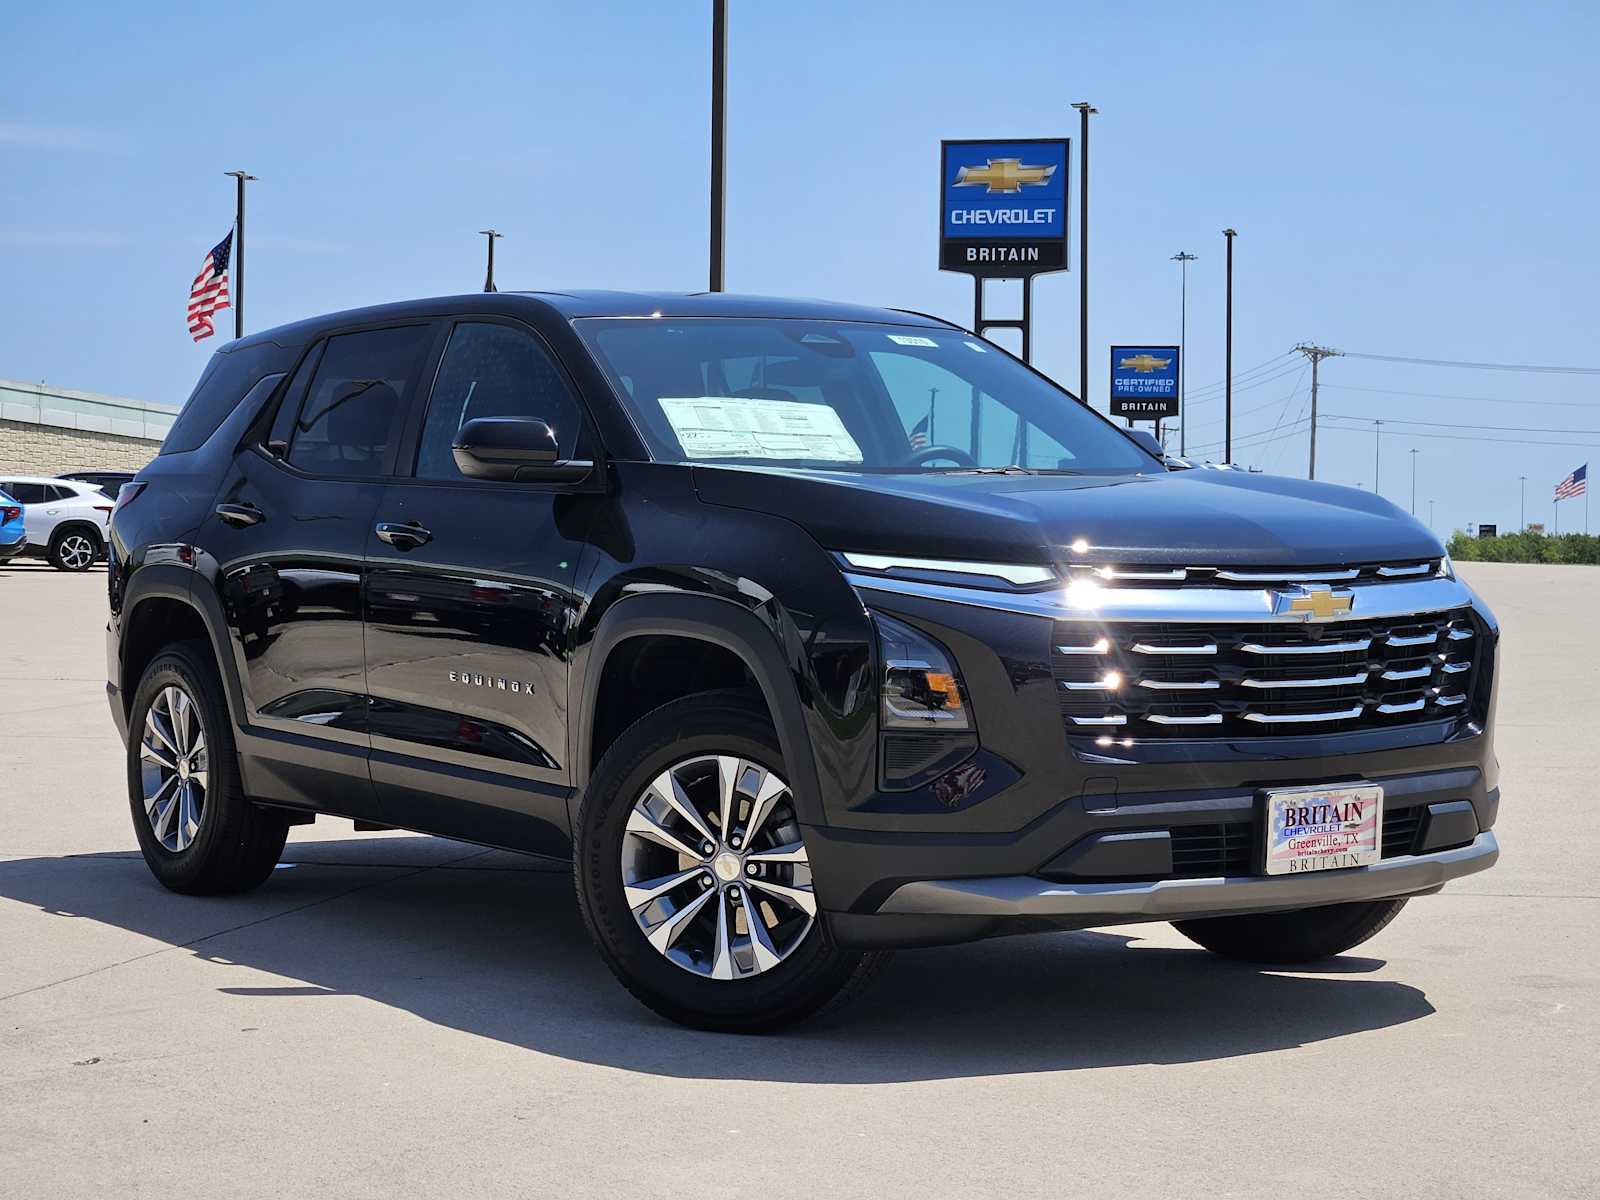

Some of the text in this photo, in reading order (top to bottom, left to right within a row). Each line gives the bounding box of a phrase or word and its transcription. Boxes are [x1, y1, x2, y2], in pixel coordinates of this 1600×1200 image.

[951, 208, 1056, 224] CHEVROLET
[966, 247, 1039, 261] BRITAIN
[1114, 378, 1175, 386] CERTIFIED
[1118, 385, 1171, 393] PRE-OWNED
[1121, 402, 1167, 411] BRITAIN
[449, 671, 535, 695] EQUINOX
[1285, 802, 1364, 827] BRITAIN
[1284, 824, 1342, 837] CHEVROLET
[1288, 832, 1359, 850] Greenville, TX
[1289, 853, 1360, 871] BRITAIN
